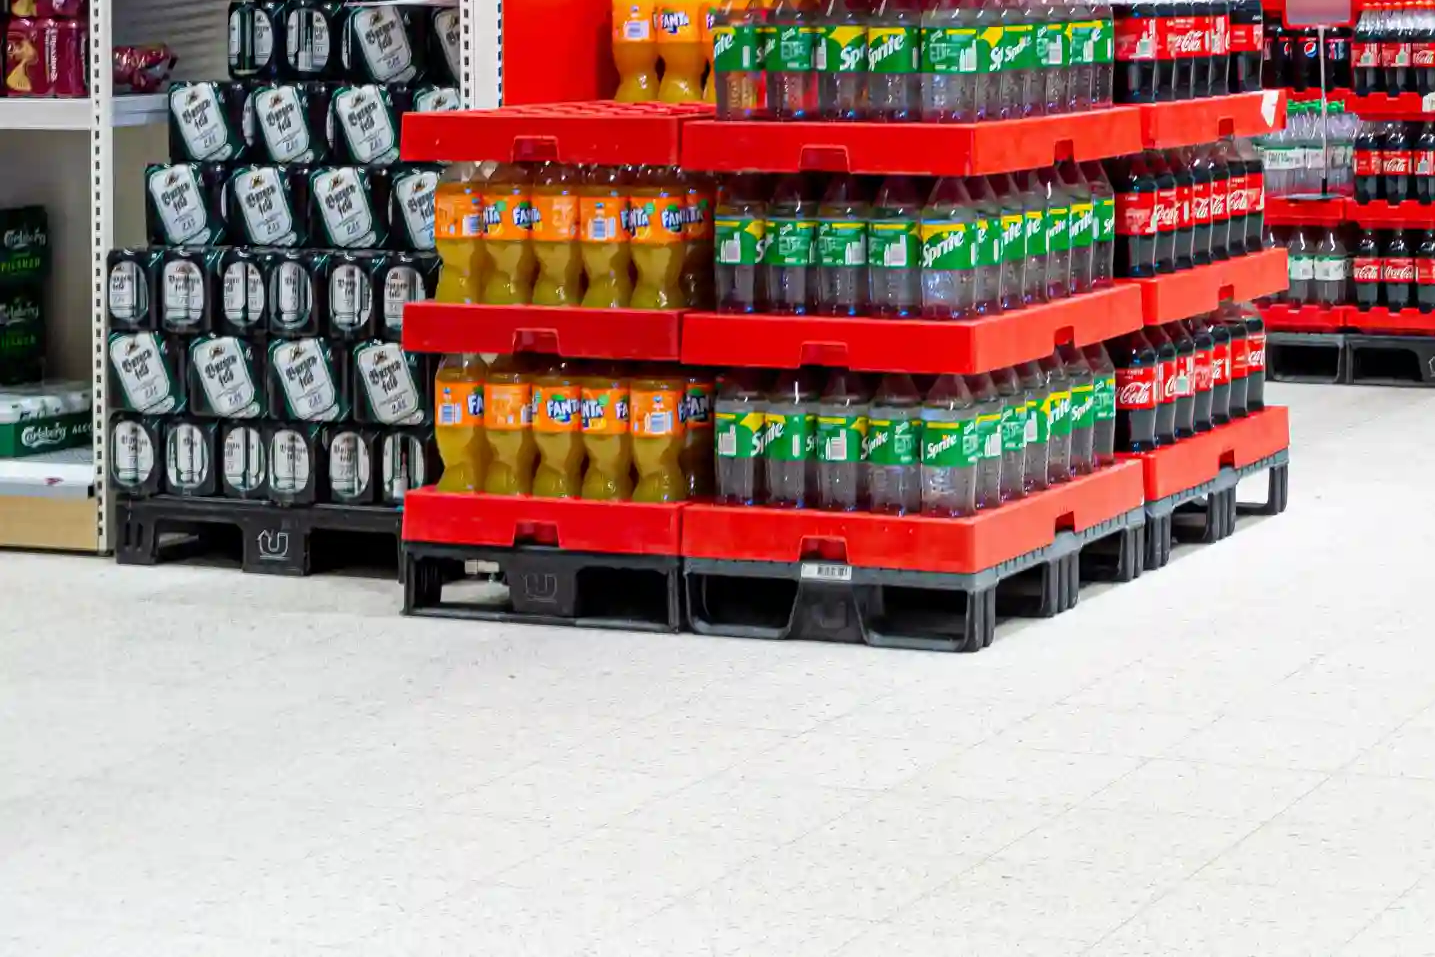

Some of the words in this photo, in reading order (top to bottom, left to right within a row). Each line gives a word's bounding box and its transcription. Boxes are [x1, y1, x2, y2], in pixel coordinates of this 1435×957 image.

[922, 230, 965, 269] Sprite
[582, 399, 603, 418] NTA
[927, 432, 958, 460] Sprite
